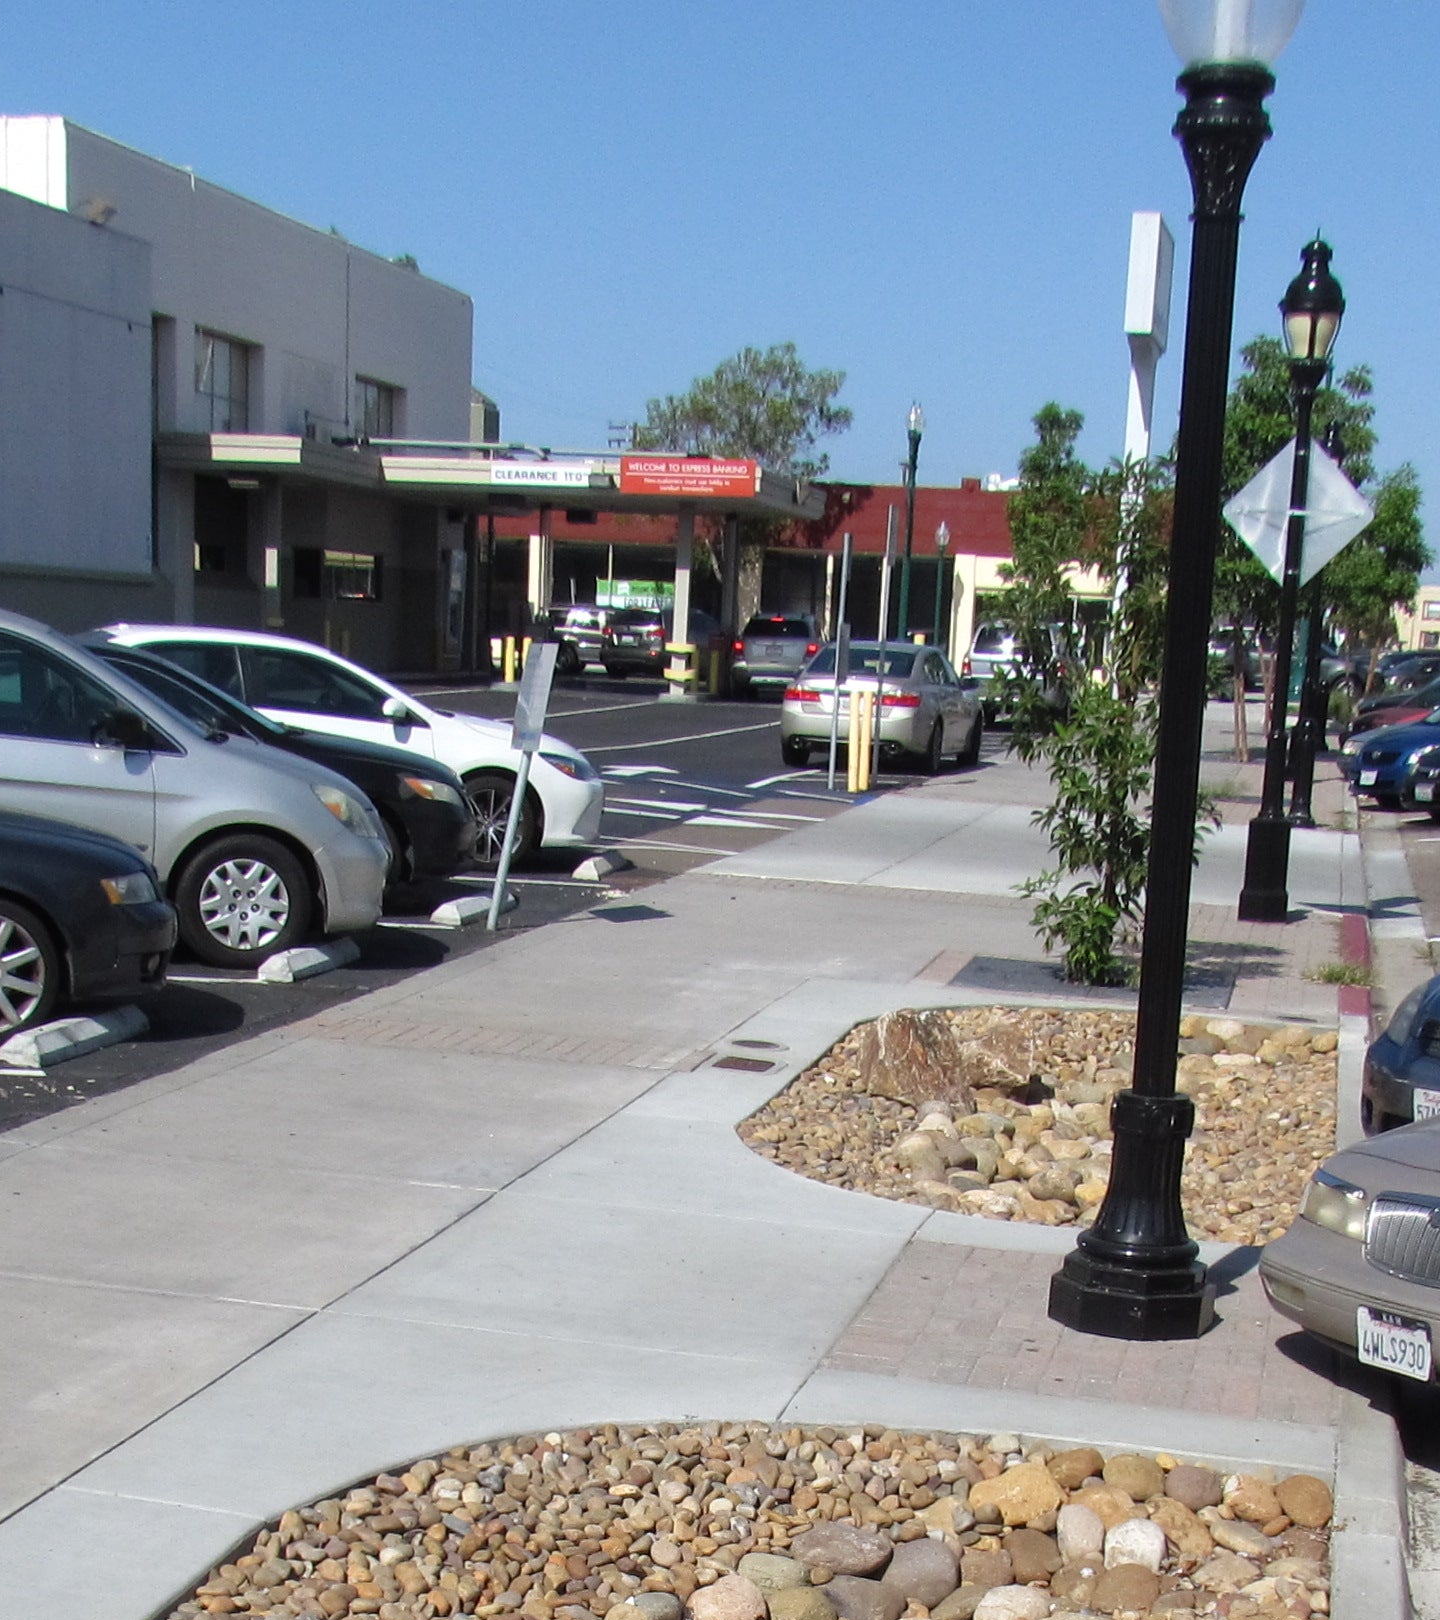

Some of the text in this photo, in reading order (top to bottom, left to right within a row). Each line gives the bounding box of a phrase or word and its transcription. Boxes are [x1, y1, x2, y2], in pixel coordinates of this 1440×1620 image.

[627, 462, 748, 475] WELCOME TO EXPRESS BANKING
[494, 469, 558, 482] CLEARANCE
